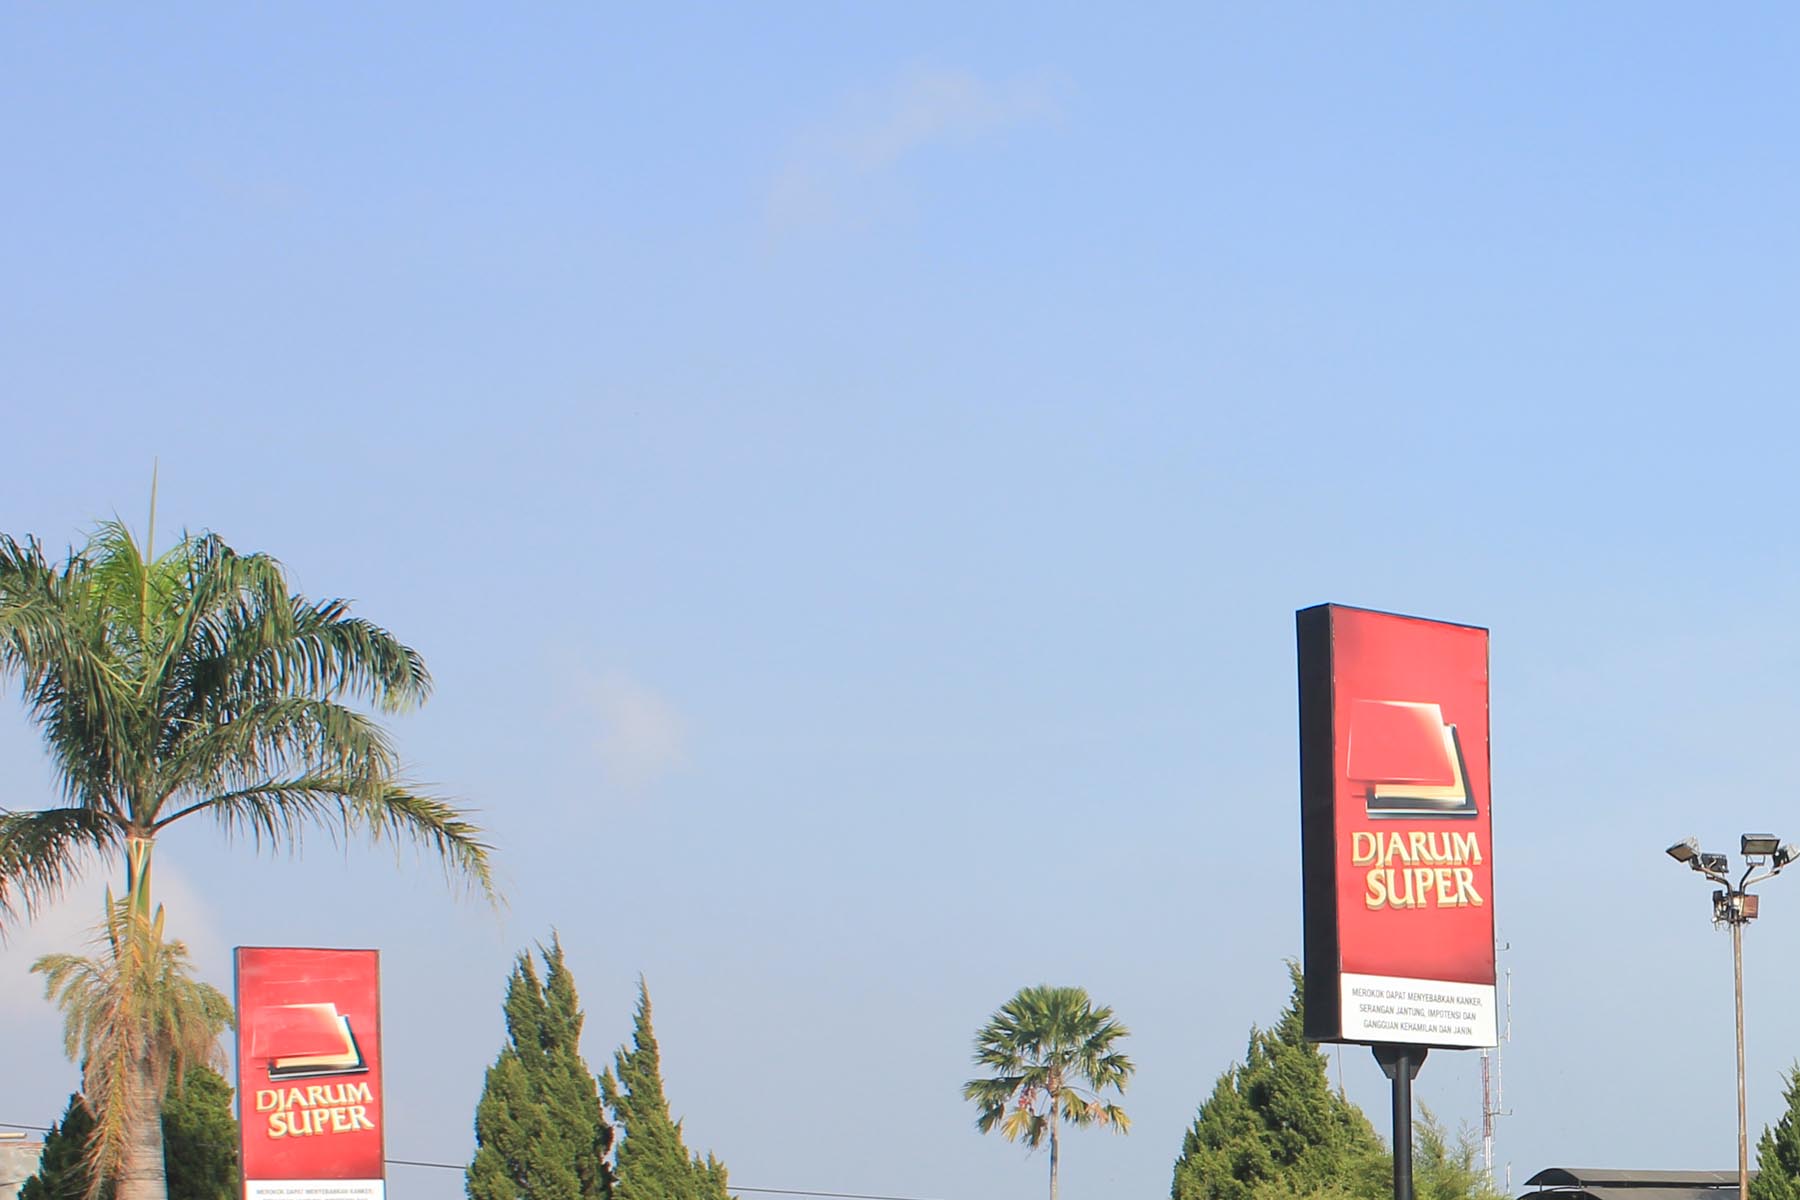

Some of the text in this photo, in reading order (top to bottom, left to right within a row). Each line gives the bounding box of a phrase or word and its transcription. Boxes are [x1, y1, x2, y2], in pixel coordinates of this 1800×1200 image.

[1351, 831, 1483, 867] DJARUM
[1365, 867, 1484, 910] SUPER
[1352, 988, 1483, 1007] MEROKOK DAPAT MENYEBABKAN KANKER,
[1359, 1003, 1477, 1021] SERANGAN JANTUNG, IMPOTENSI DAN
[1363, 1019, 1473, 1035] GANGGUAN KEHAMILAN DAN JANIN
[256, 1082, 375, 1112] DJARUM
[268, 1105, 376, 1138] SUPER
